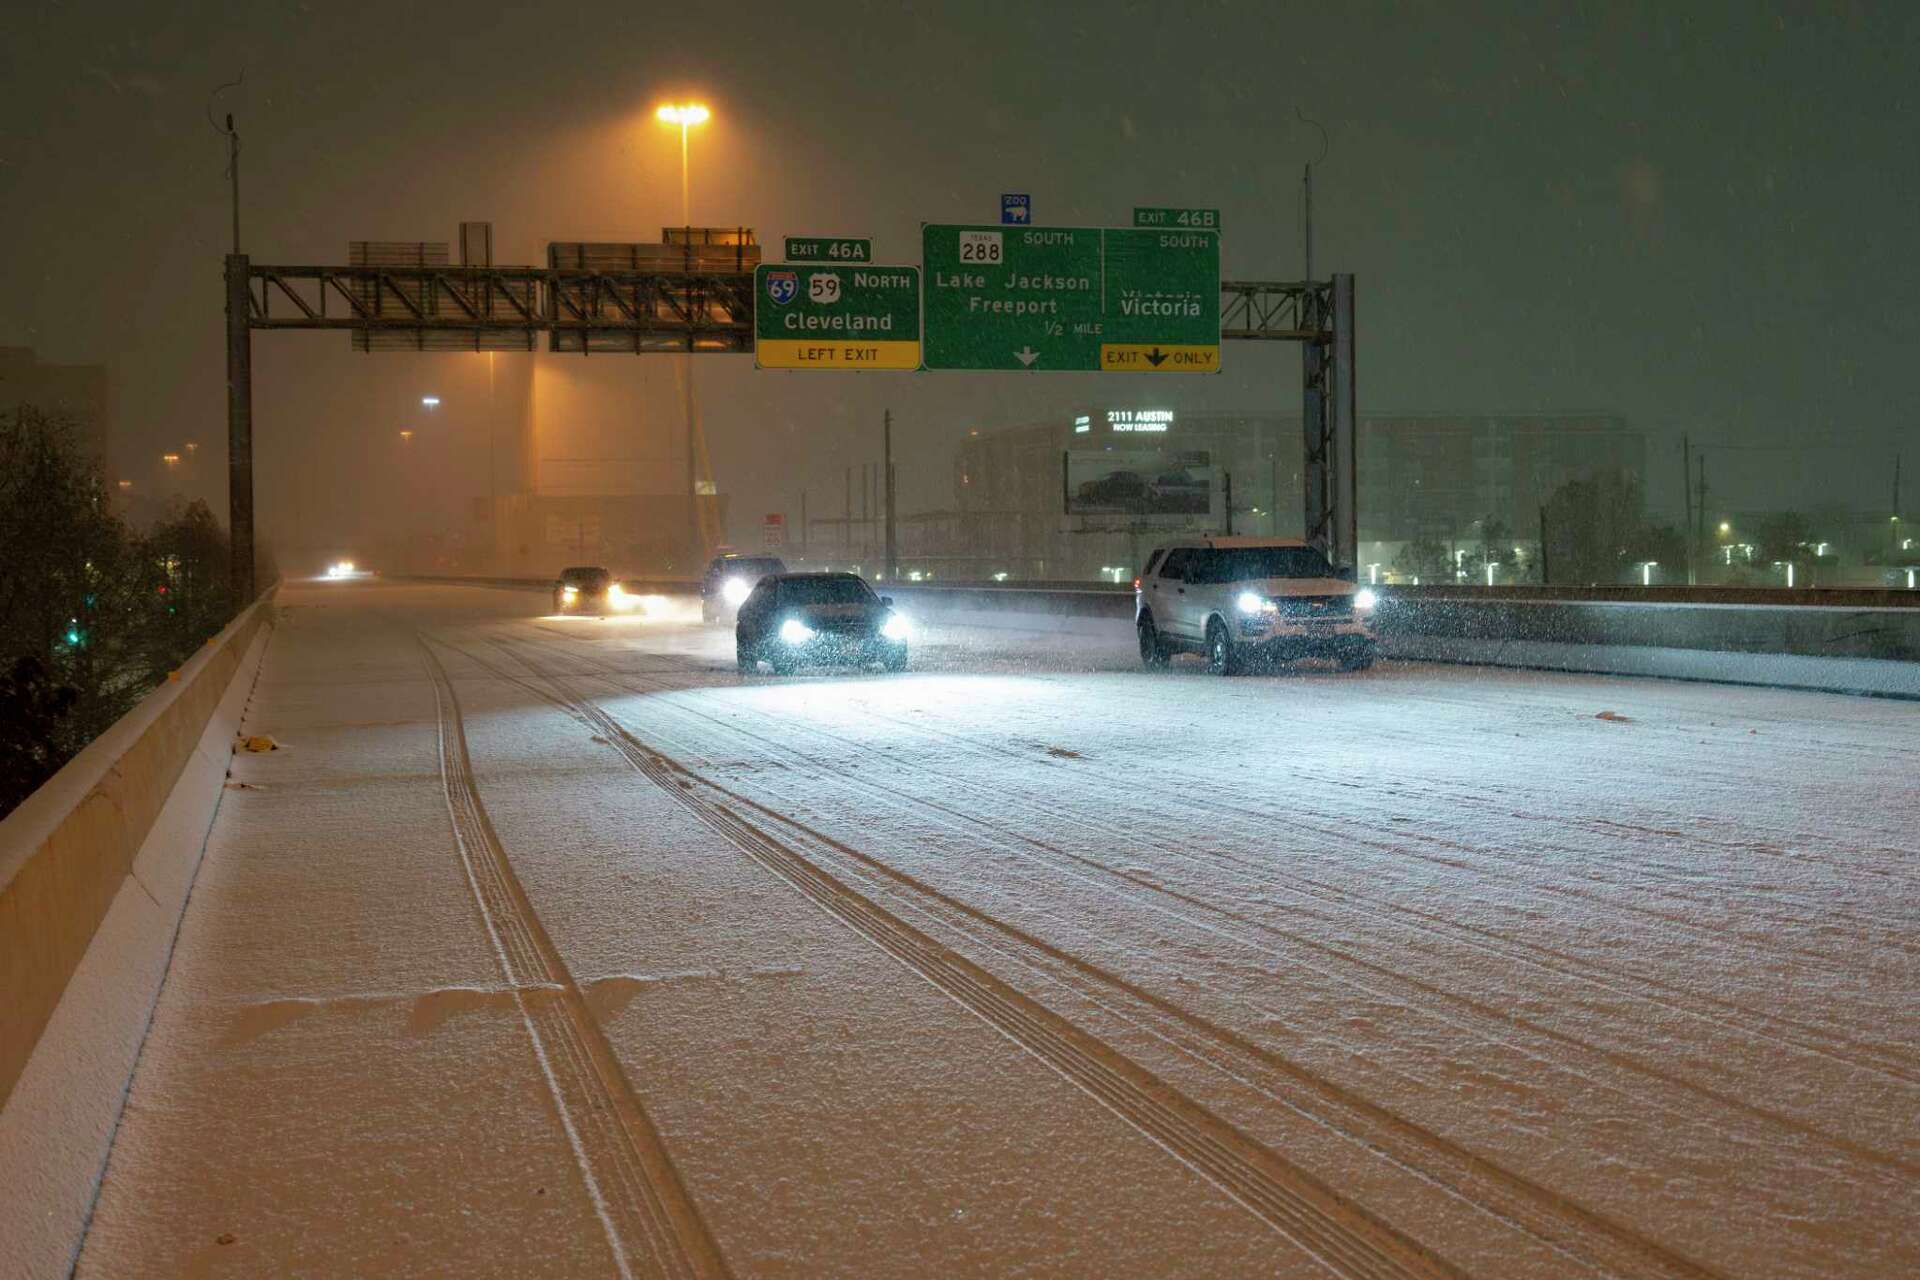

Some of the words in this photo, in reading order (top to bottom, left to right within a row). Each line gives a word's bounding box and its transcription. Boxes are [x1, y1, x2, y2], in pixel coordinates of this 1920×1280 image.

[1006, 196, 1026, 205] ZOO
[1138, 212, 1166, 223] EXIT
[1177, 211, 1214, 226] 46B
[963, 243, 999, 260] 288
[1024, 232, 1073, 245] SOUTH
[1160, 235, 1208, 248] SOUTH
[791, 244, 818, 255] EXIT
[829, 243, 864, 258] 46A
[770, 280, 794, 298] 69
[812, 279, 837, 296] 59
[854, 272, 910, 288] NORTH
[936, 272, 985, 288] Lake
[1004, 273, 1089, 290] Jackson
[970, 297, 1057, 316] Freeport
[1121, 299, 1200, 316] Victoria
[784, 312, 892, 330] Cleveland
[1073, 323, 1103, 334] MILE
[798, 348, 835, 361] LEFT
[845, 349, 877, 361] EXIT
[1106, 351, 1138, 363] EXIT
[1173, 352, 1213, 364] ONLY
[1107, 411, 1132, 422] 2111
[1135, 411, 1173, 422] AUSTIN
[1113, 423, 1134, 432] NOW
[1134, 423, 1167, 432] LEASING
